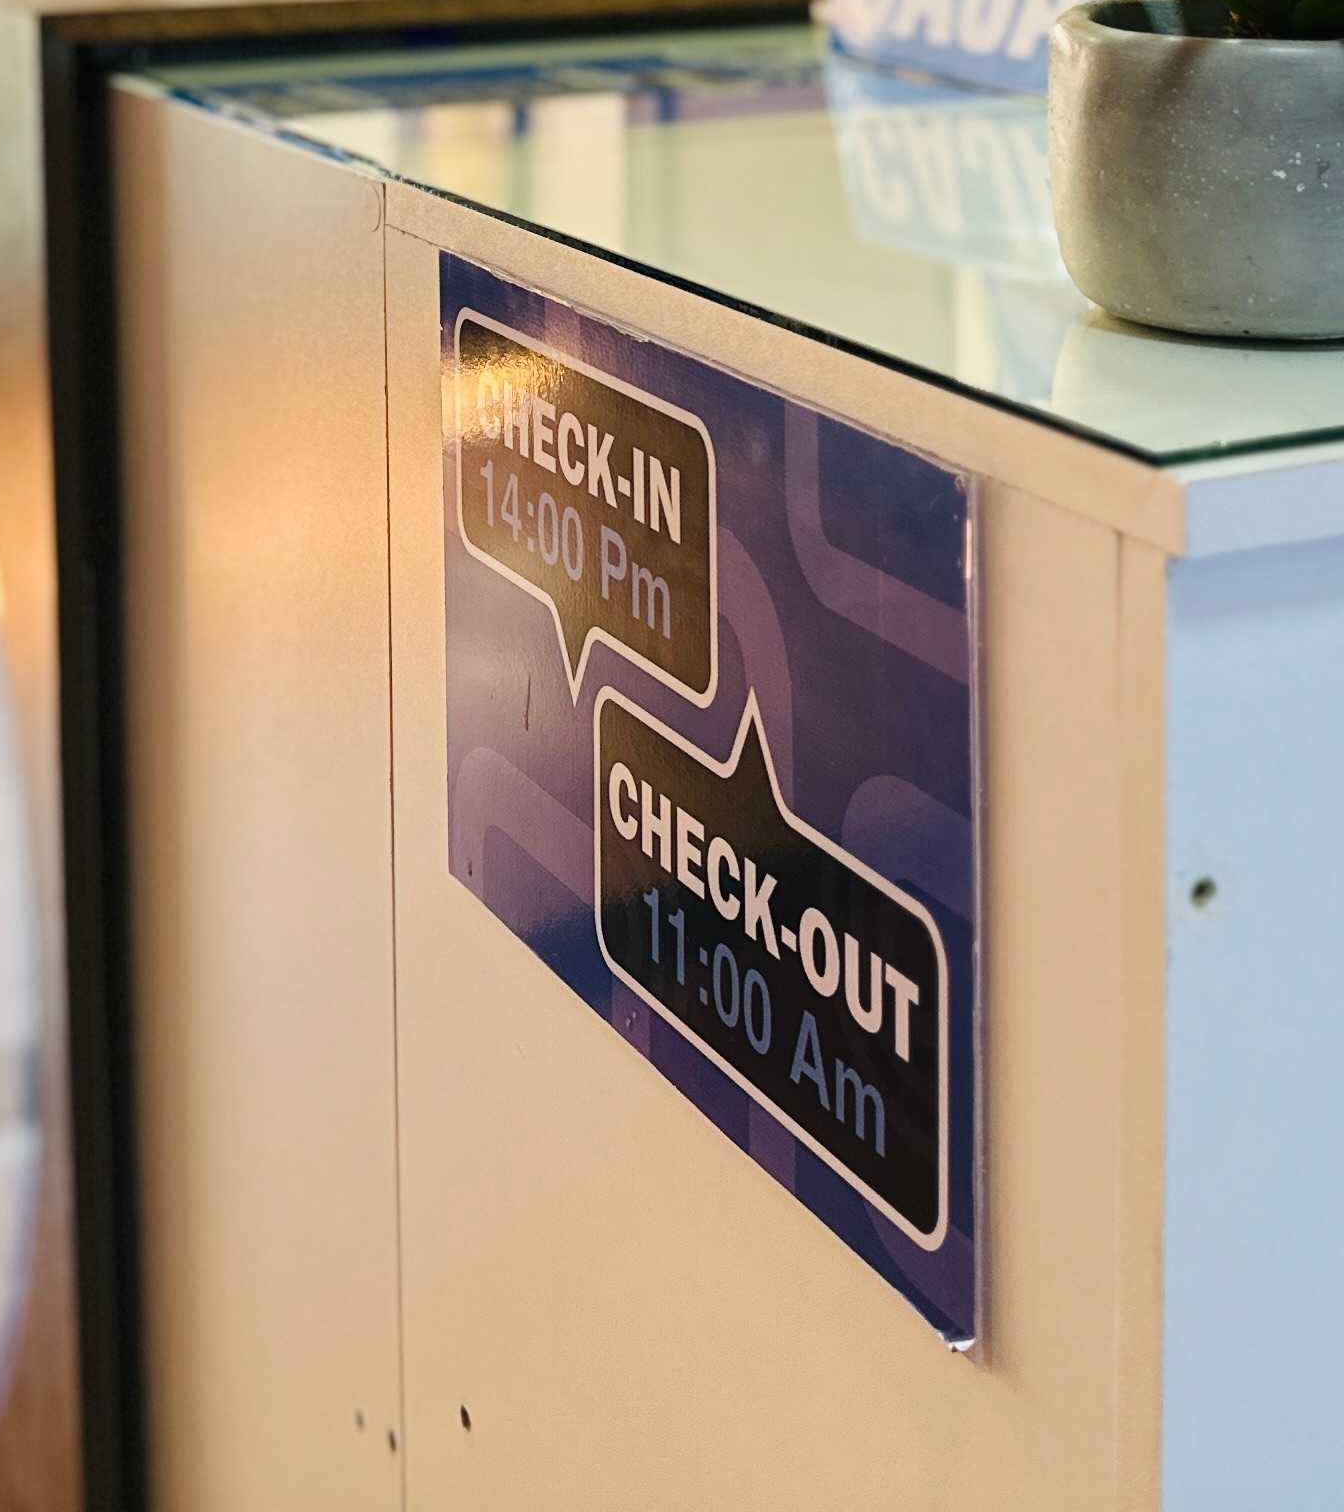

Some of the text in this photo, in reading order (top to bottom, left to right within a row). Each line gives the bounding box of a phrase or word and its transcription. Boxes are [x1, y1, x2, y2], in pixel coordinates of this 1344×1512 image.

[476, 367, 681, 545] CHECK-IN
[479, 458, 671, 639] 14:00 Pm
[608, 761, 920, 1063] CHECK-OUT
[642, 887, 886, 1158] 11:00 Am
